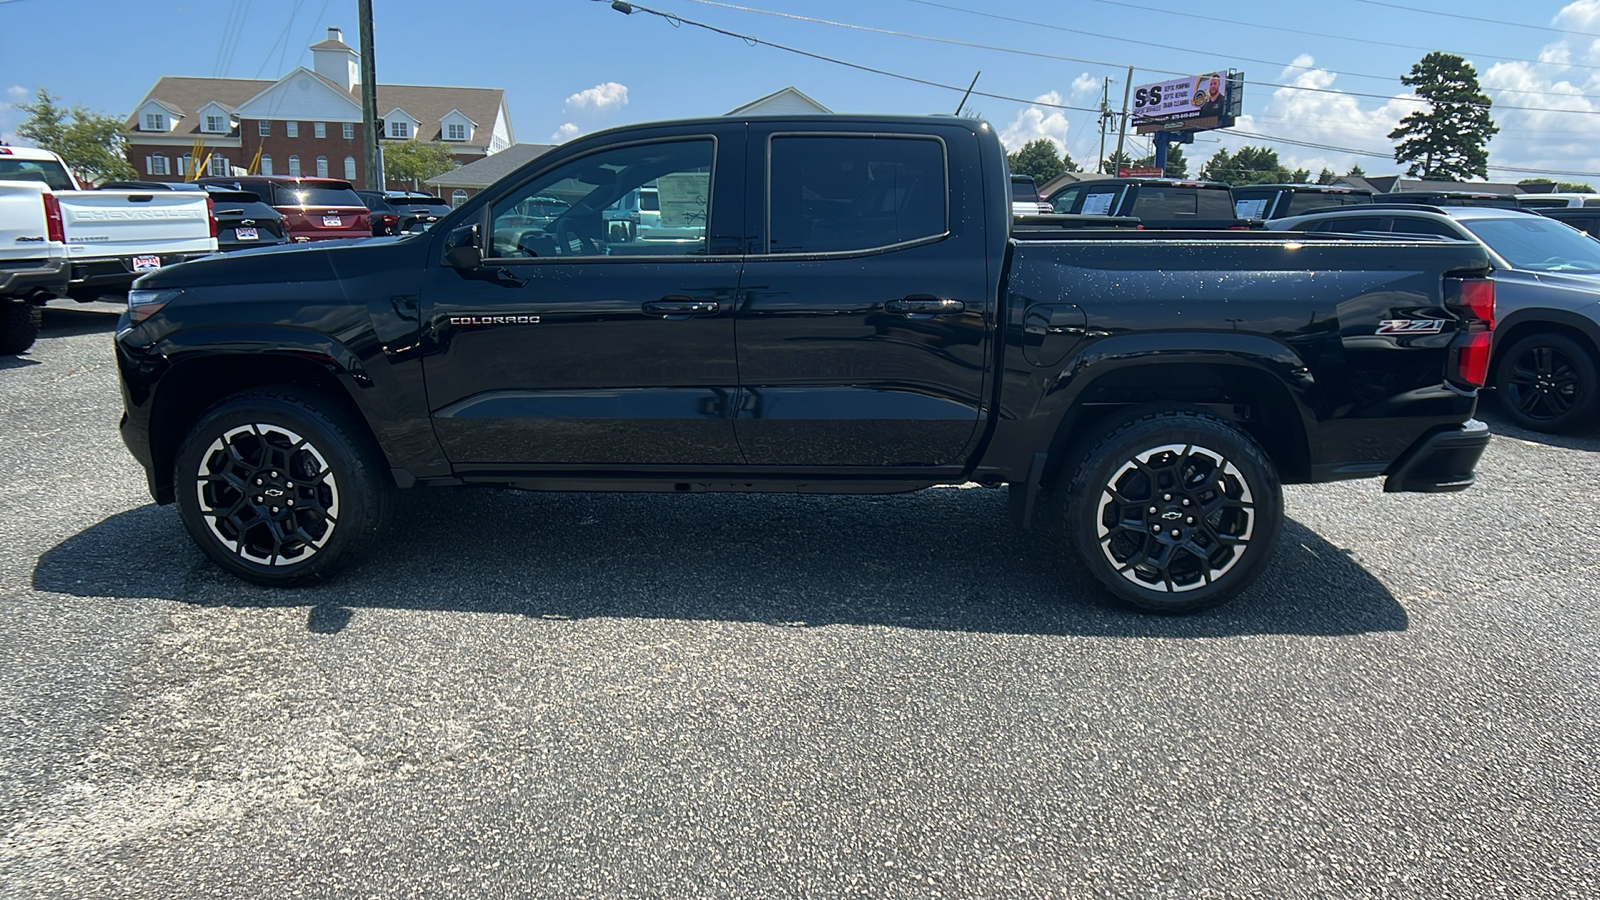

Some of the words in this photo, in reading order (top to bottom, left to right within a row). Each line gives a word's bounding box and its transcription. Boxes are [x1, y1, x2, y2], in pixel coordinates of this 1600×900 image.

[75, 209, 200, 220] CHEVROLET
[450, 316, 540, 325] COLORADO
[1375, 319, 1446, 335] Z71
